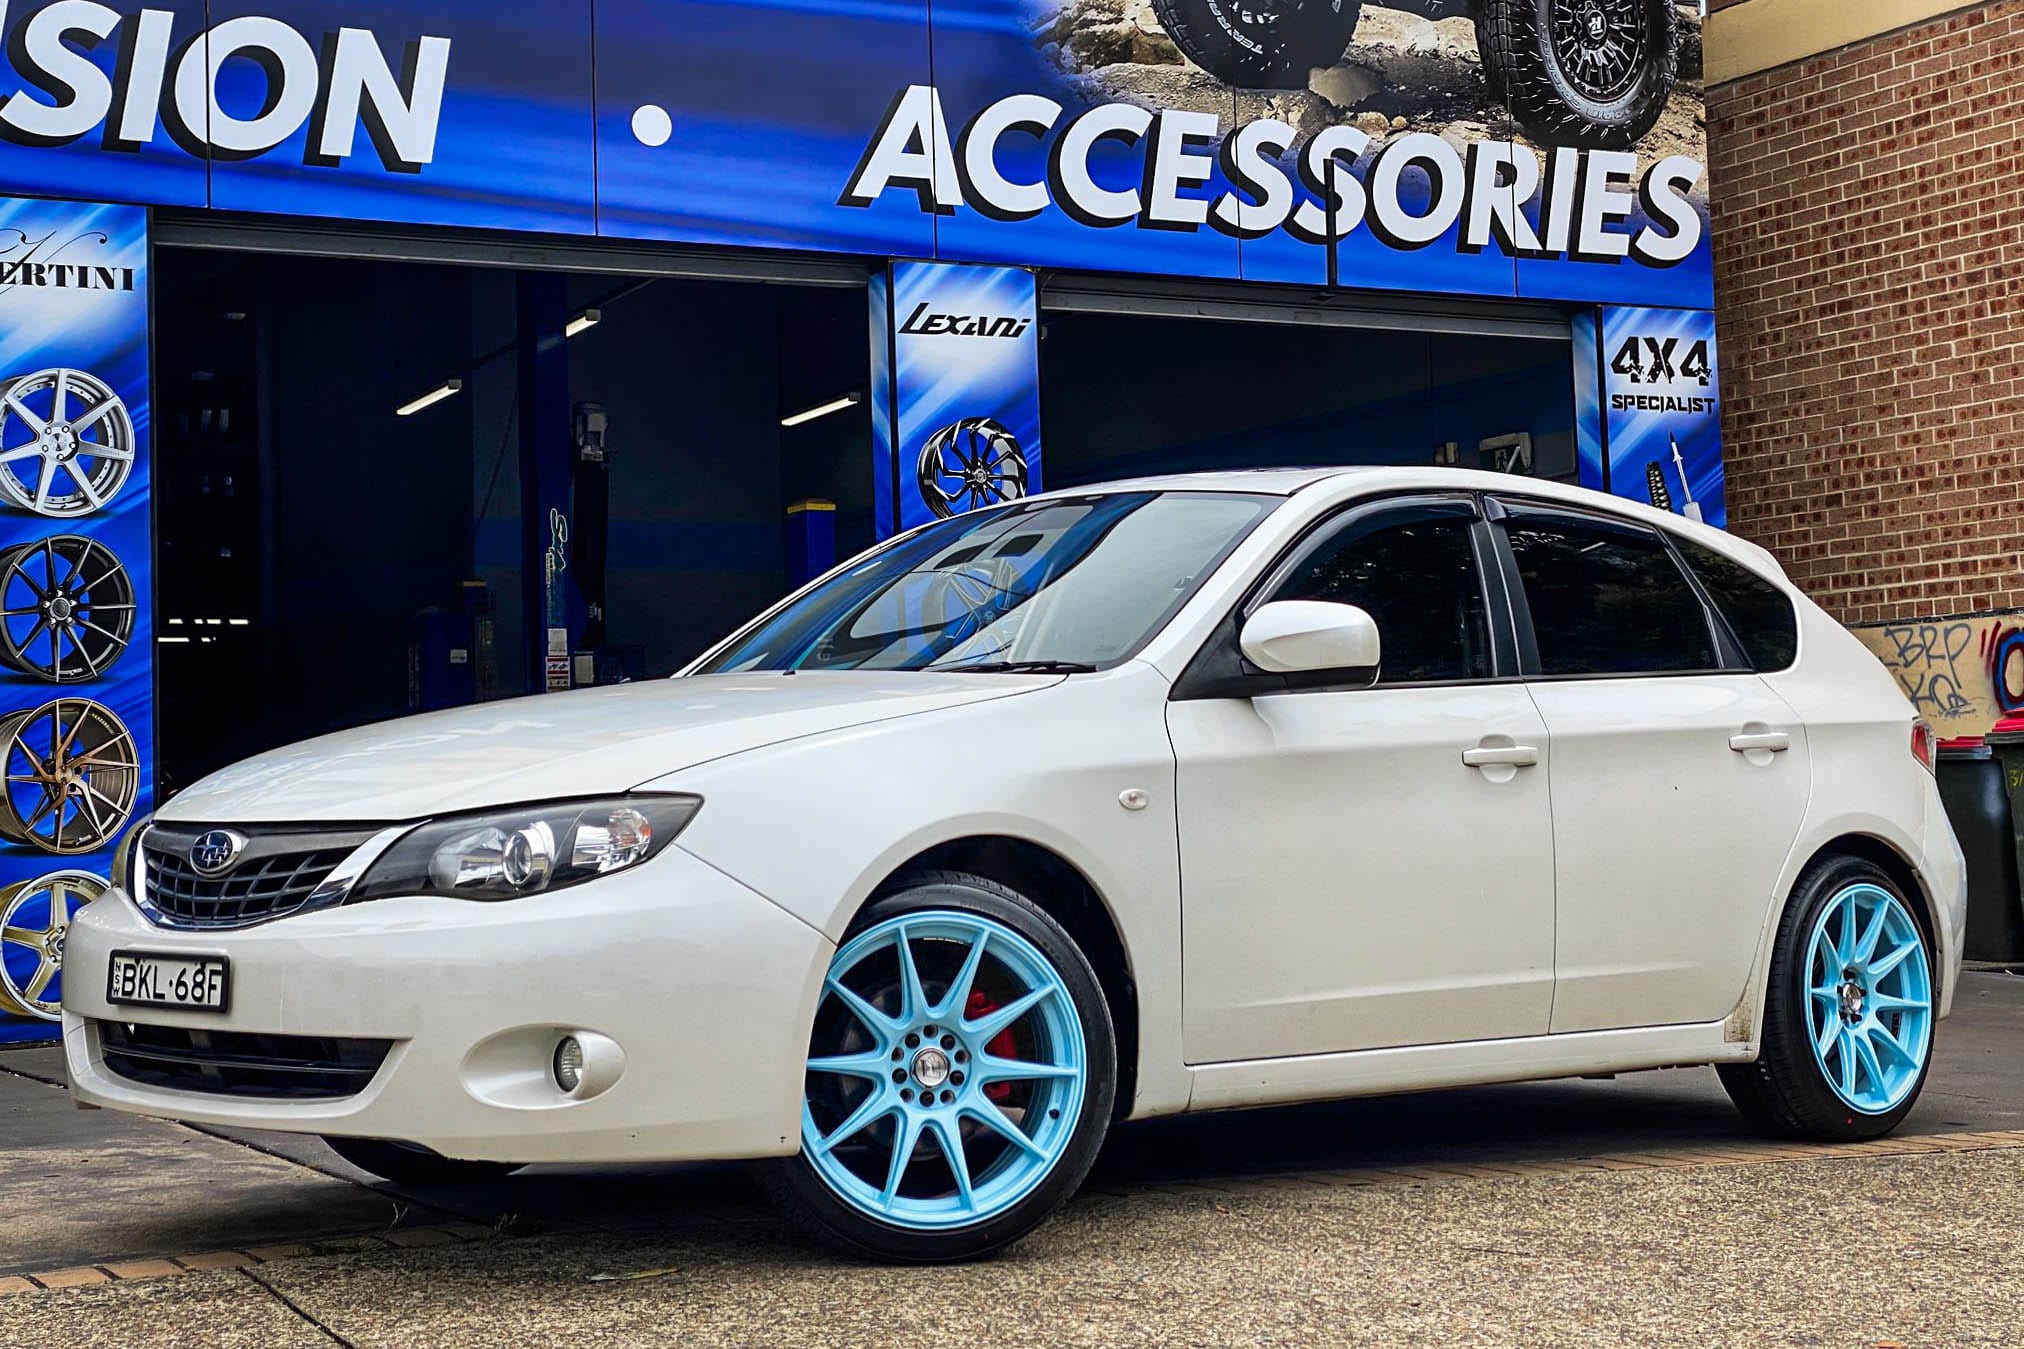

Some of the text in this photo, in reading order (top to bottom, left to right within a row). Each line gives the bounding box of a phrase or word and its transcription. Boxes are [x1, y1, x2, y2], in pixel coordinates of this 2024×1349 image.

[0, 0, 451, 165] SION
[848, 85, 1703, 263] ACCESSORIES
[1612, 394, 1715, 415] SPECIALIST
